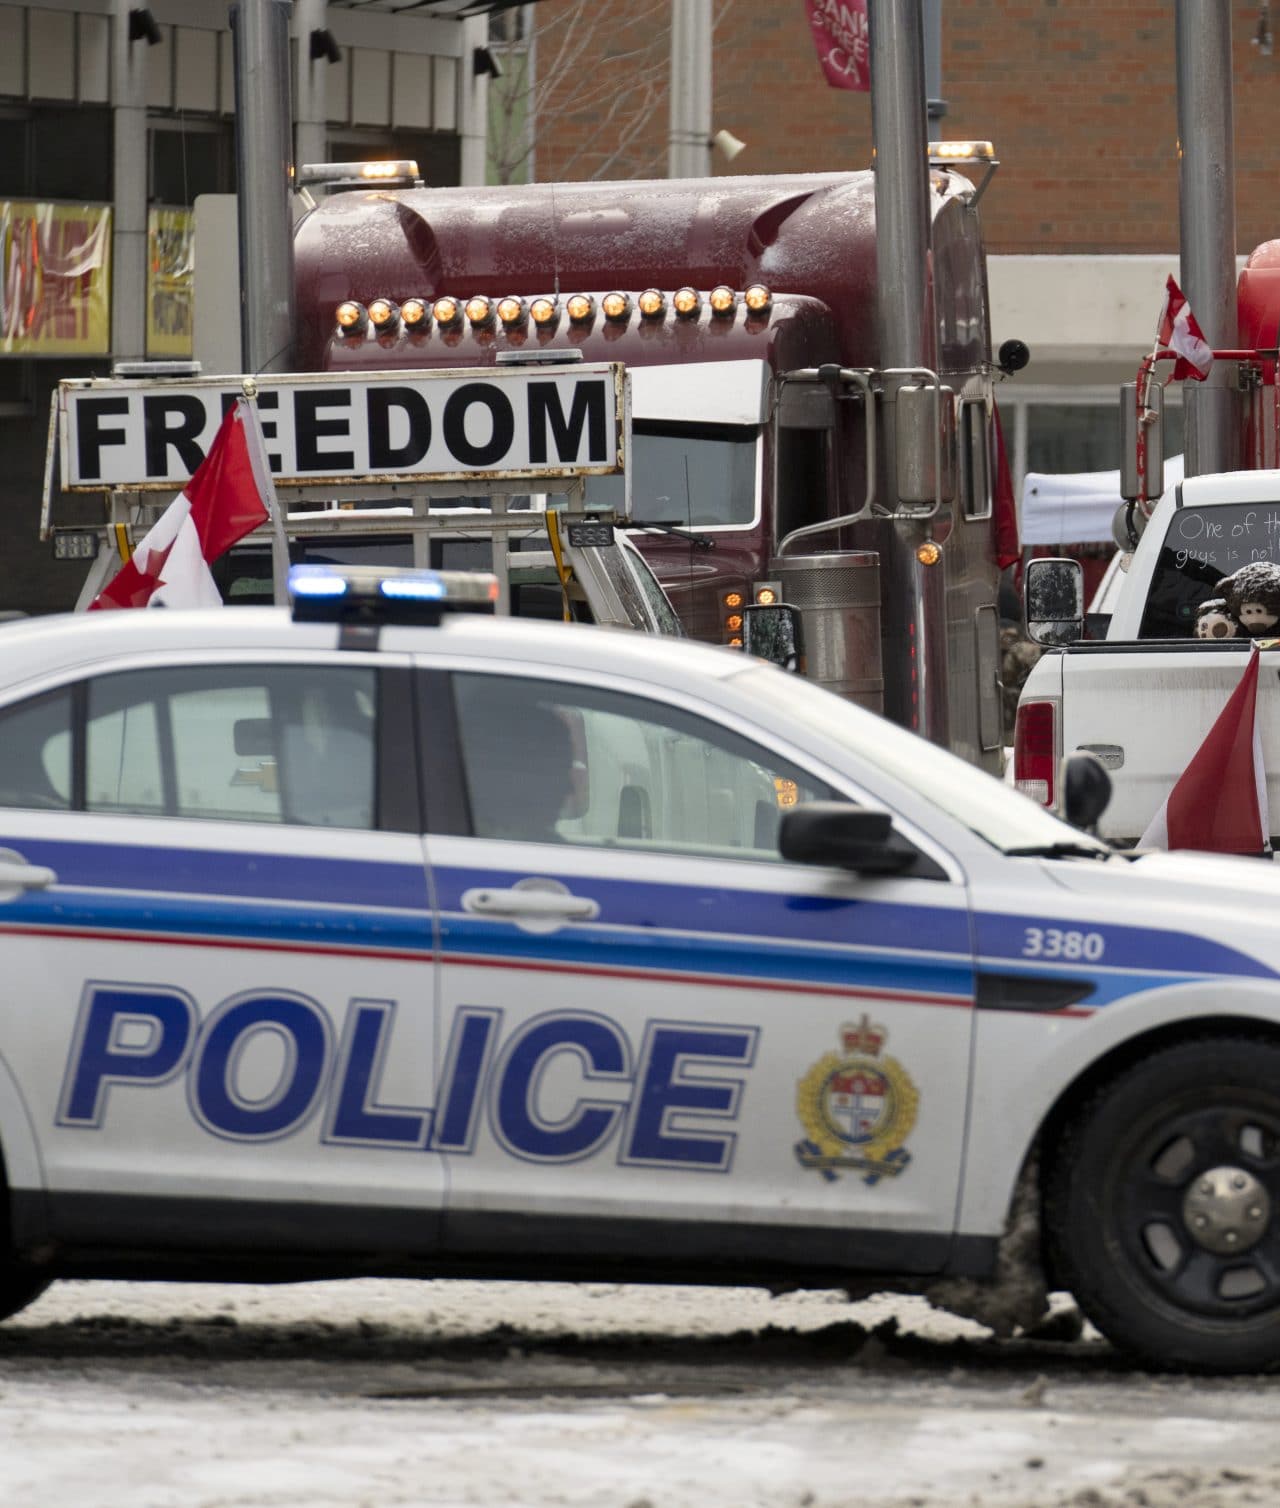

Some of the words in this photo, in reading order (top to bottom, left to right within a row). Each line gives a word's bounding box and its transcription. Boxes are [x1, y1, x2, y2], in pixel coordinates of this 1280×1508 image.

[812, 10, 869, 63] STREE
[814, 0, 868, 40] ANK
[1179, 513, 1224, 540] One
[1231, 512, 1257, 538] of
[1175, 548, 1217, 569] guys
[1226, 547, 1240, 561] is
[1251, 541, 1274, 561] not
[1022, 927, 1105, 961] 3380
[54, 978, 762, 1174] POLICE
